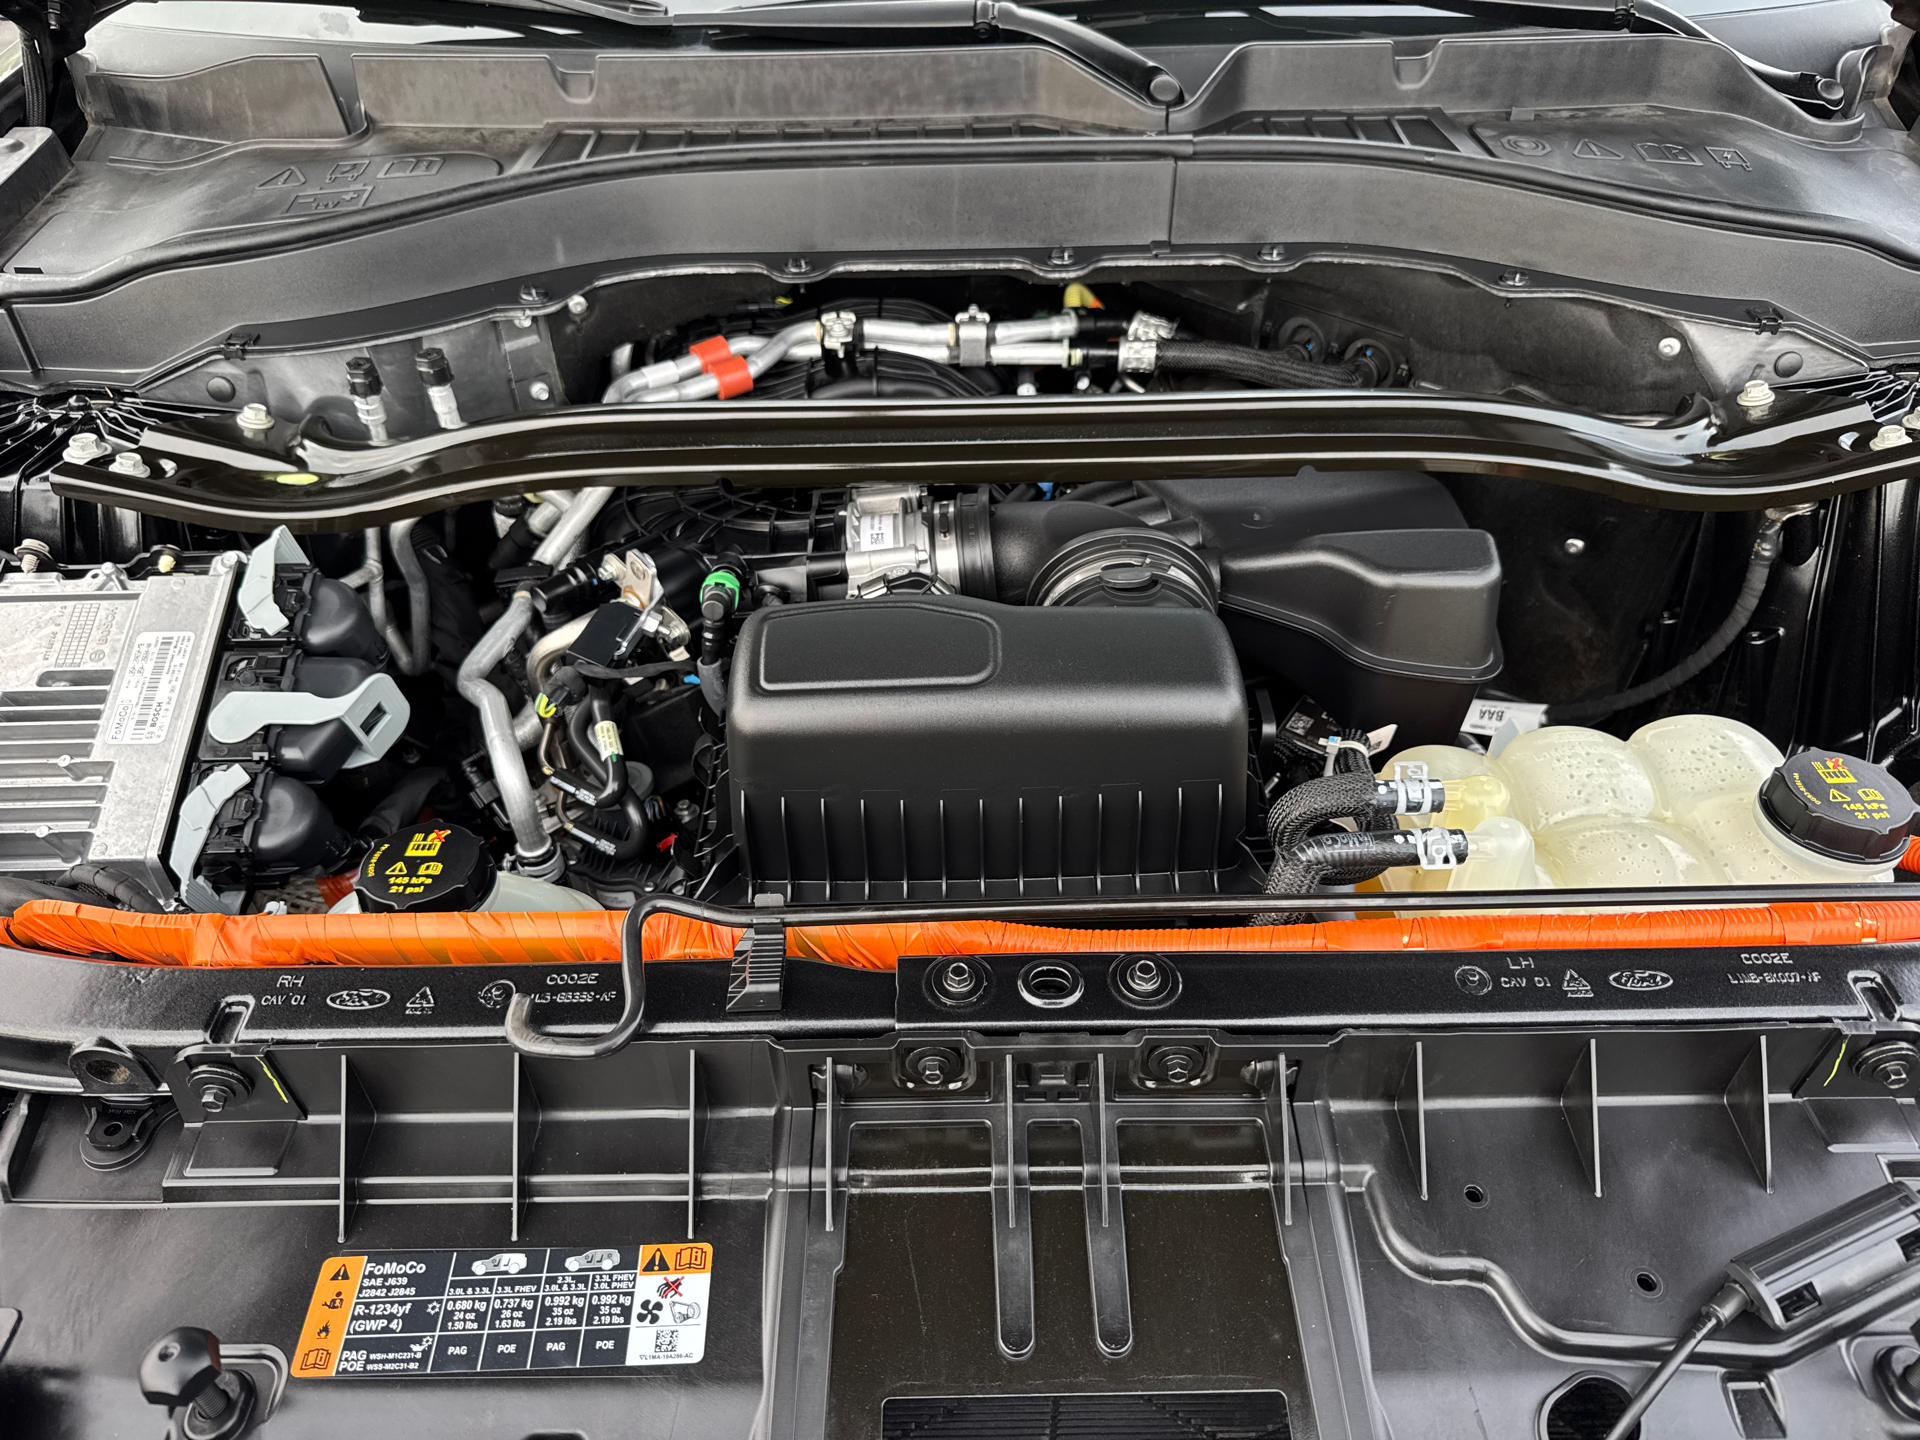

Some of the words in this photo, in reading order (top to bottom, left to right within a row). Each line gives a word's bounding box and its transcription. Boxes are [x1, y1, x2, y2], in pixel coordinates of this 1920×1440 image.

[149, 701, 163, 727] BOSCH
[1479, 708, 1504, 722] BAA
[110, 705, 130, 740] FoMoCo
[1843, 803, 1864, 811] 145
[1864, 802, 1888, 810] kPa
[1855, 811, 1870, 820] 21
[1872, 811, 1890, 820] psi
[404, 885, 424, 894] psi
[1506, 957, 1535, 969] LH
[276, 975, 305, 987] RH
[1501, 977, 1527, 987] CAV
[261, 995, 286, 1005] CAV
[365, 1261, 426, 1275] FoMoCo
[362, 1278, 383, 1286] SAE
[385, 1277, 408, 1286] J639
[595, 1274, 611, 1282] 3.3L
[612, 1273, 635, 1281] FHEV
[514, 1285, 537, 1293] FHEV
[593, 1282, 610, 1290] 3.0L
[611, 1281, 634, 1289] PHEV
[359, 1288, 387, 1297] J2842
[388, 1287, 416, 1296] J2845
[446, 1300, 473, 1310] 0.680
[474, 1299, 487, 1311] kg
[494, 1298, 520, 1309] 0.737
[521, 1298, 534, 1310] kg
[544, 1296, 571, 1306] 0.992
[572, 1295, 585, 1307] kg
[591, 1295, 618, 1305] 0.992
[619, 1294, 632, 1306] kg
[354, 1303, 412, 1316] R-1234yf
[500, 1310, 512, 1318] 26
[512, 1310, 523, 1318] oz
[551, 1307, 563, 1316] 35
[599, 1306, 610, 1314] 35
[453, 1311, 464, 1320] 24
[592, 1315, 611, 1325] 2.19
[611, 1315, 625, 1324] lbs
[349, 1319, 388, 1334] (GWP
[389, 1318, 403, 1332] 4)
[447, 1321, 464, 1330] 1.50
[465, 1321, 478, 1329] lbs
[495, 1320, 512, 1328] 1.63
[512, 1319, 526, 1328] lbs
[545, 1317, 563, 1326] 2.19
[564, 1316, 577, 1325] lbs
[496, 1344, 517, 1353] POE
[546, 1341, 566, 1351] PAG
[595, 1340, 615, 1350] POE
[341, 1350, 367, 1361] PAG
[447, 1346, 468, 1355] PAG
[338, 1361, 366, 1371] POE
